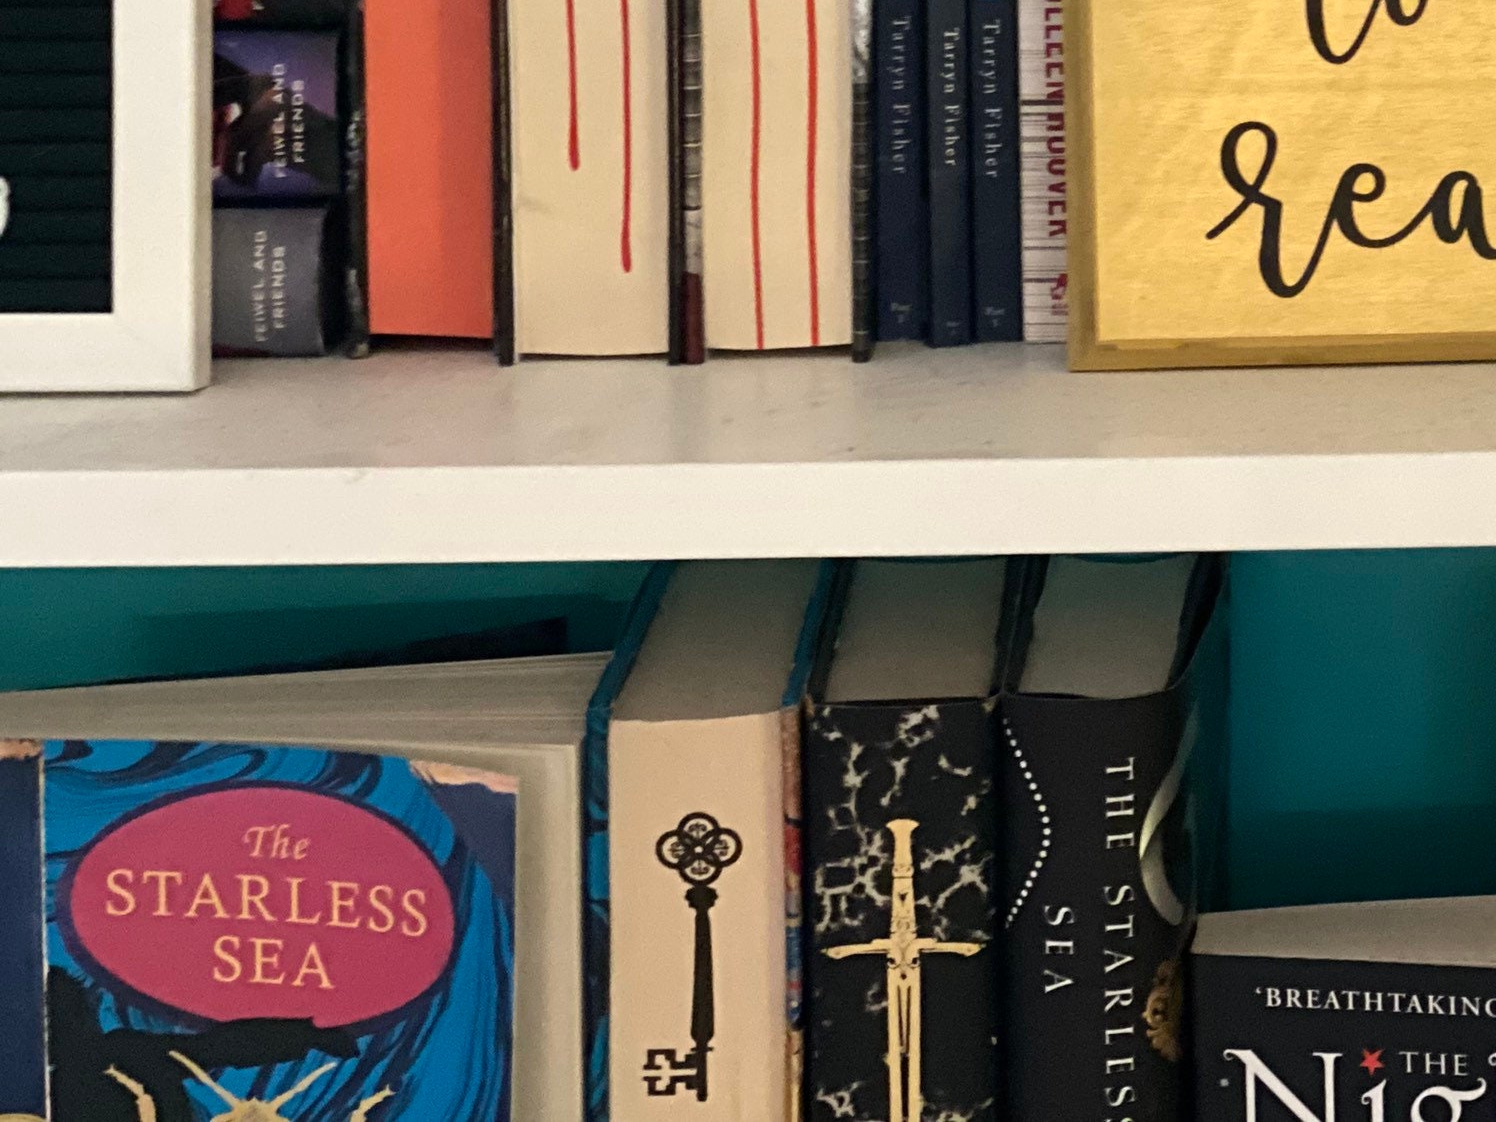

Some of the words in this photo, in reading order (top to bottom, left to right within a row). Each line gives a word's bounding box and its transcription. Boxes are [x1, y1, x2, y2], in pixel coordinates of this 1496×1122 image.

[271, 63, 286, 104] AND
[940, 27, 961, 94] Tarryn
[979, 18, 1001, 95] Tarryn
[272, 112, 288, 178] FEIWEL
[291, 80, 306, 164] FRIENDS
[944, 104, 961, 166] Fisher
[984, 107, 1003, 178] Fisher
[253, 229, 268, 273] AND
[254, 278, 267, 343] FEIWEL
[272, 245, 286, 329] FRIENDS
[1105, 757, 1136, 850] THE
[241, 823, 311, 862] The
[104, 868, 430, 938] STARLESS
[212, 934, 336, 991] SEA
[1043, 903, 1076, 995] SEA
[1103, 883, 1137, 1122] STARLES
[1398, 1049, 1470, 1077] THE
